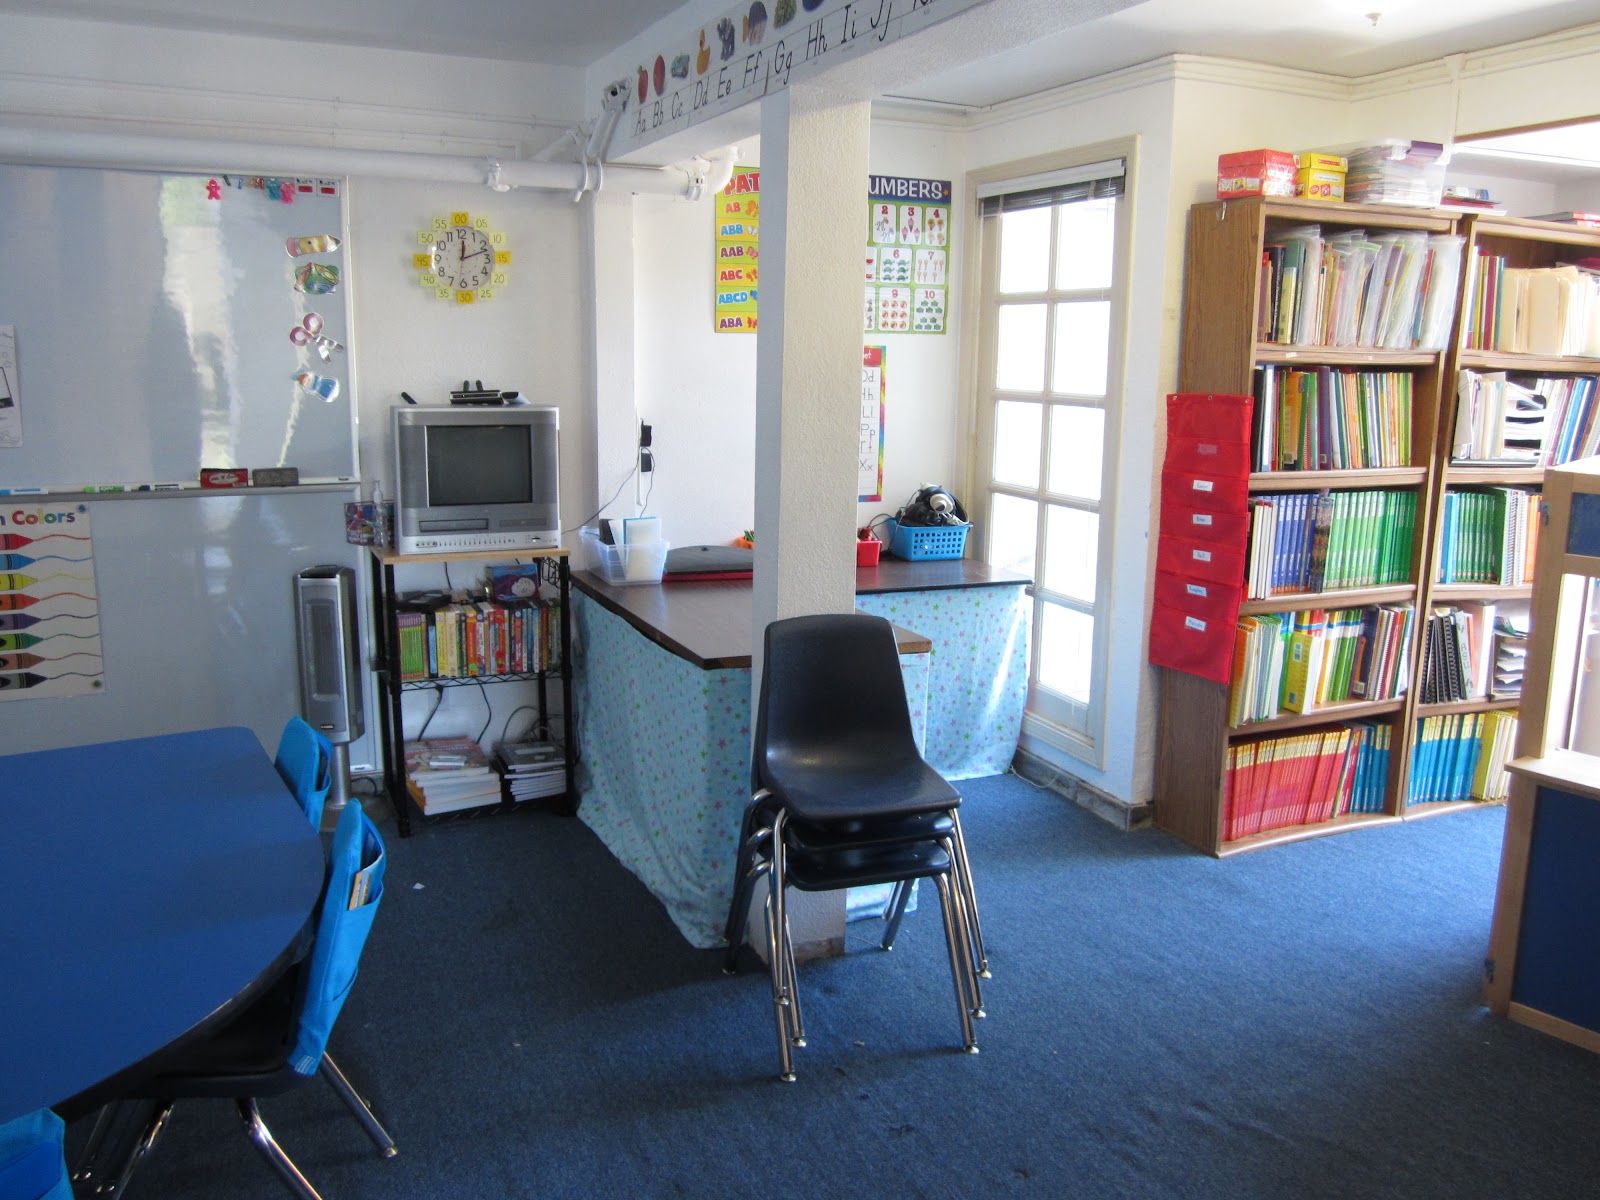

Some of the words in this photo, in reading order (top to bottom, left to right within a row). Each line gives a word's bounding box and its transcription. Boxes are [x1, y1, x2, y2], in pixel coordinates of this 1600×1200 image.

[634, 108, 646, 136] Aa
[652, 100, 664, 128] Bb
[672, 92, 683, 120] Cc
[694, 76, 710, 110] Dd
[717, 66, 732, 99] Ee
[742, 50, 763, 88] Ff
[774, 40, 793, 85] Gg
[806, 17, 828, 60] Hh
[840, 4, 858, 44] Ii
[870, 0, 892, 42] Jj
[868, 177, 942, 200] UMBERS
[726, 201, 741, 214] AB
[882, 205, 888, 215] 2
[908, 206, 914, 216] 3
[934, 208, 940, 218] 4
[454, 214, 467, 224] 00
[476, 218, 488, 228] 05
[435, 219, 447, 230] 55
[456, 228, 467, 240] 12
[721, 224, 744, 236] ABB
[421, 233, 434, 244] 50
[446, 232, 453, 242] 11
[471, 232, 476, 242] 1
[493, 234, 502, 244] 10
[436, 240, 446, 251] 10
[480, 240, 488, 252] 2
[720, 246, 744, 258] AAB
[893, 249, 900, 258] 6
[928, 250, 934, 260] 7
[434, 254, 442, 264] 9
[484, 254, 490, 264] 3
[498, 254, 508, 262] 15
[438, 266, 446, 277] 8
[481, 266, 488, 276] 4
[720, 269, 744, 281] ABC
[423, 276, 434, 284] 40
[448, 276, 454, 286] 7
[460, 278, 468, 288] 6
[472, 276, 479, 286] 5
[494, 274, 505, 284] 20
[440, 288, 450, 298] 35
[460, 293, 471, 302] 30
[480, 290, 492, 298] 25
[718, 291, 748, 304] ABCD
[892, 289, 898, 298] 9
[924, 290, 935, 299] 10
[720, 317, 743, 328] ABA
[860, 424, 876, 442] Pp
[860, 459, 873, 471] Xx
[12, 508, 76, 525] Colors
